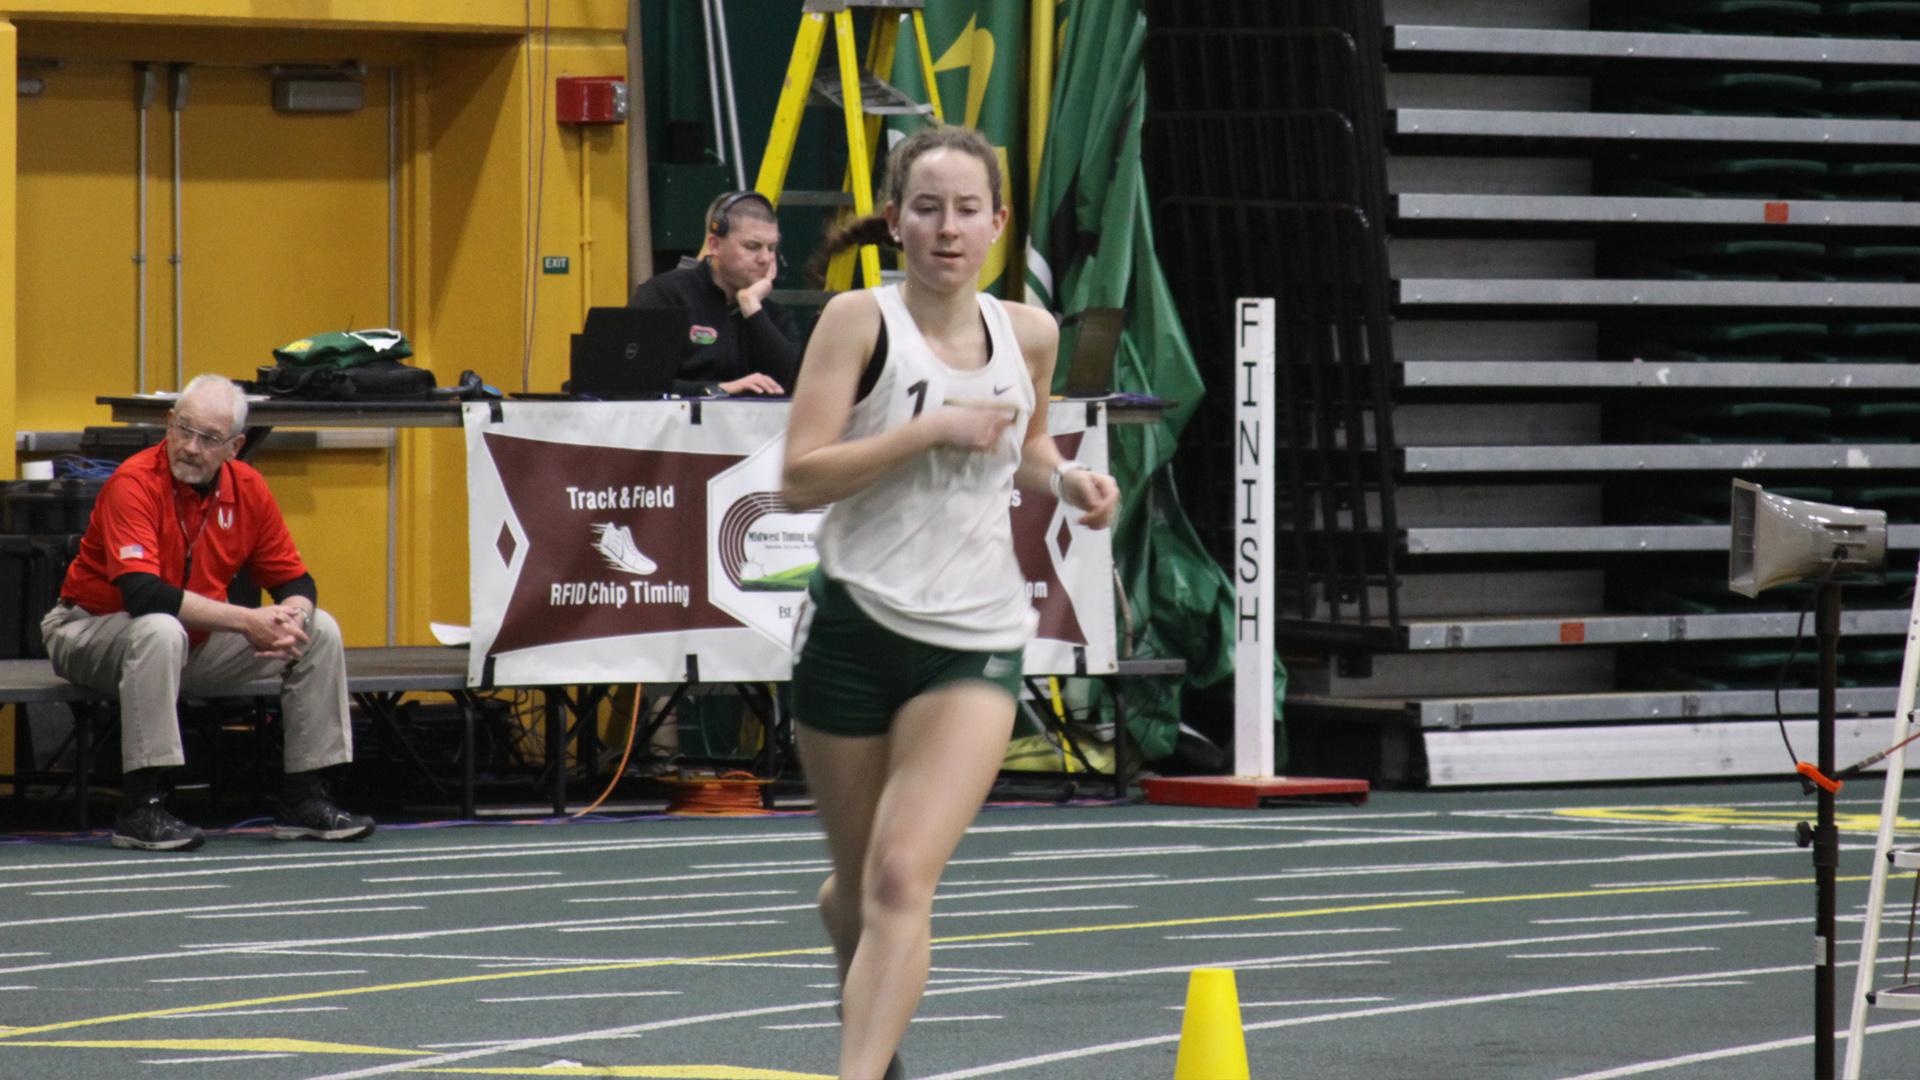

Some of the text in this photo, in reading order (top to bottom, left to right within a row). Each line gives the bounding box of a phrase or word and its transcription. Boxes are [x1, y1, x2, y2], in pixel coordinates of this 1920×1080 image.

[545, 257, 566, 268] EXIT
[1239, 302, 1260, 643] FINISH
[566, 485, 675, 510] Track & Field
[550, 580, 690, 609] RFID Chip Timing
